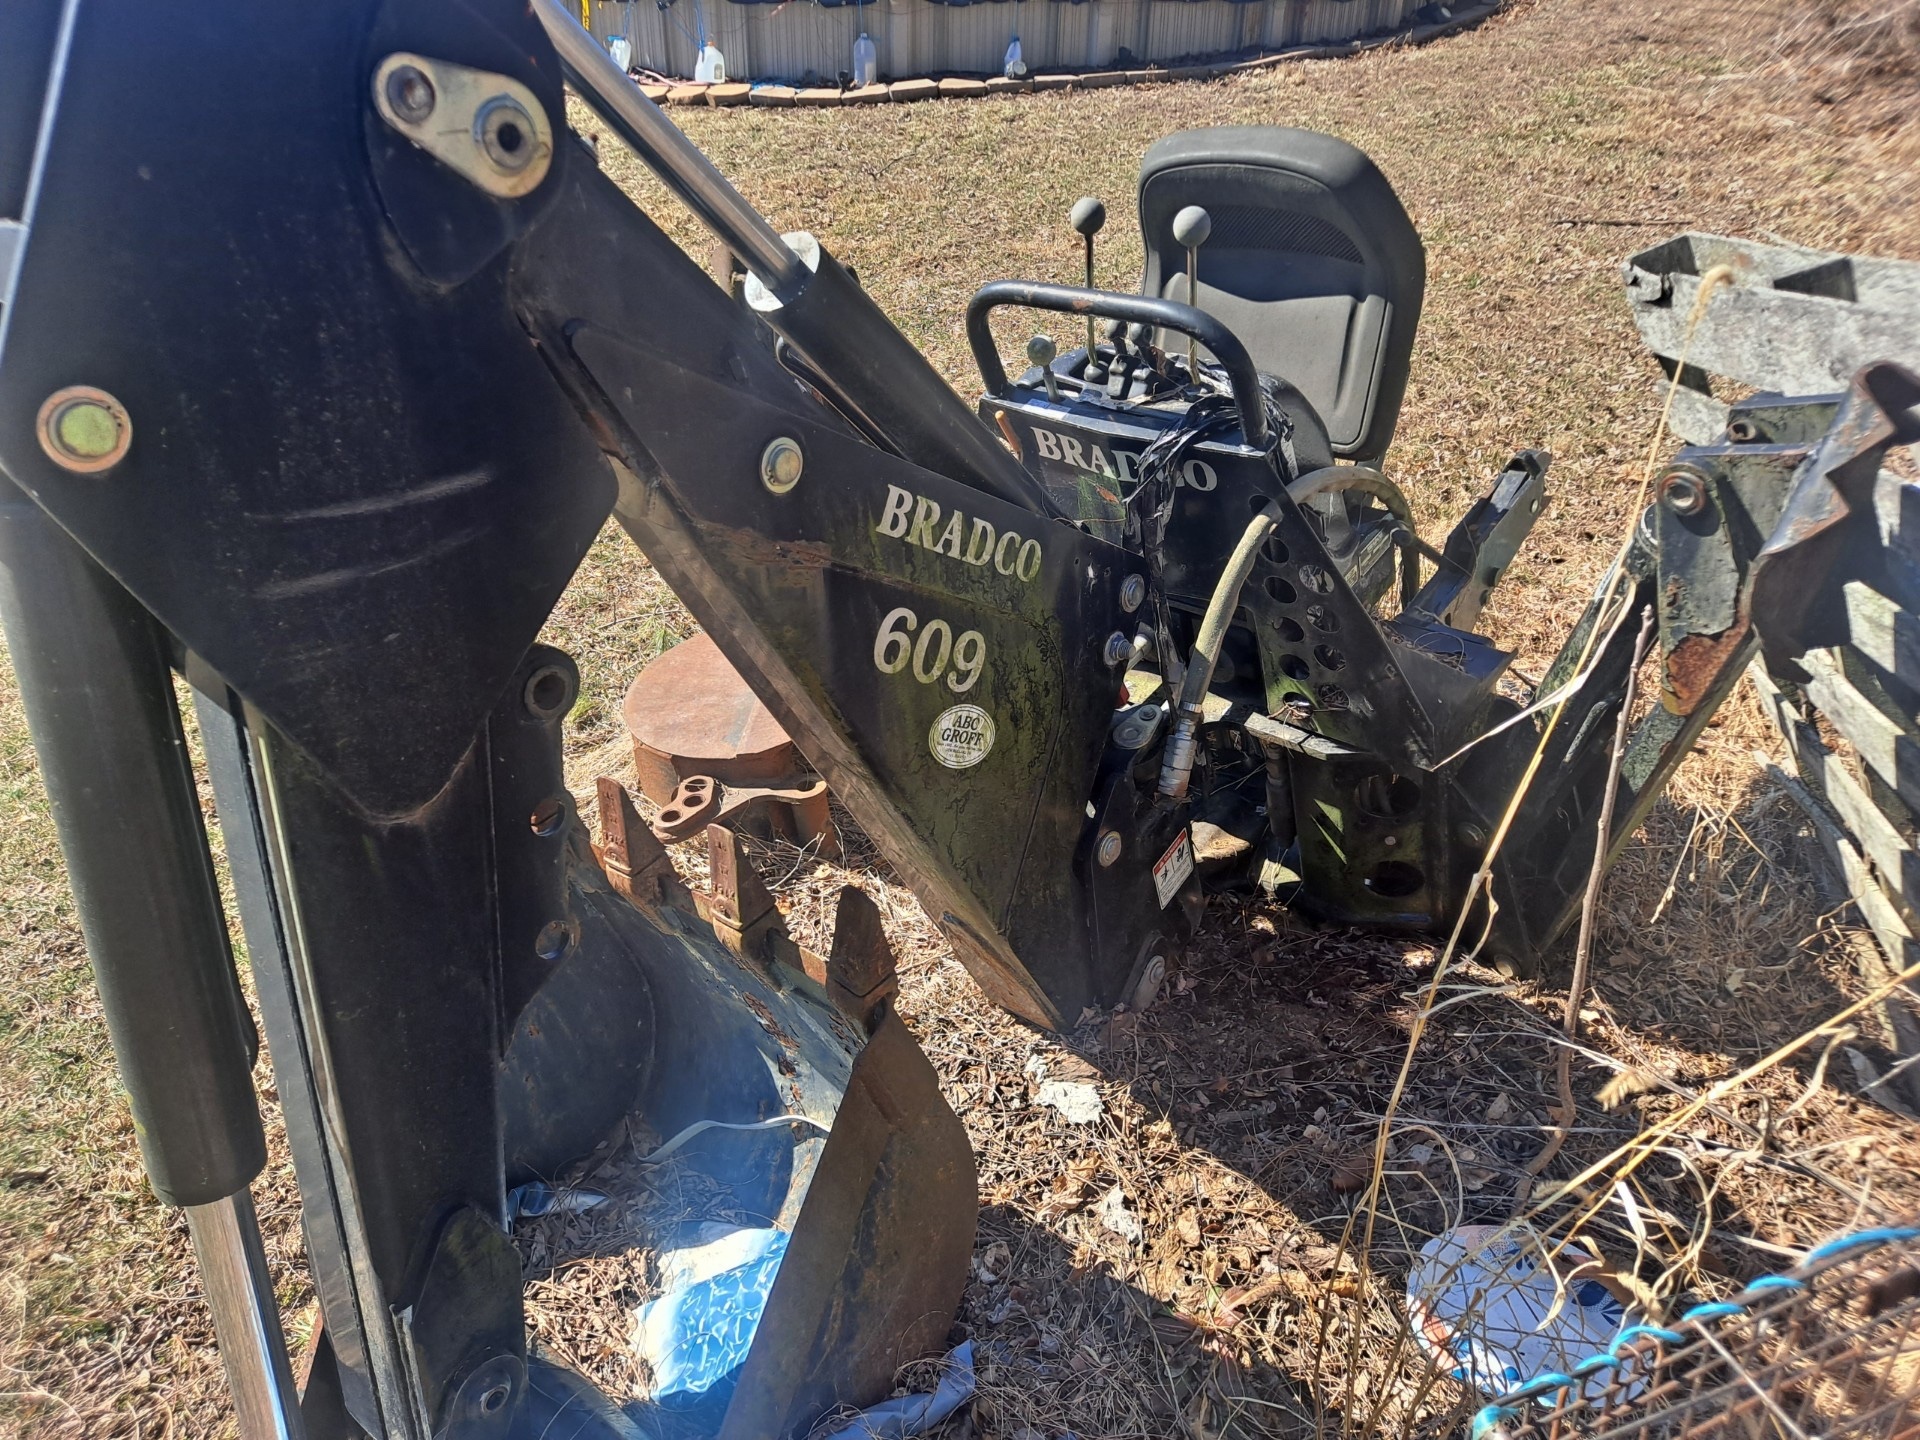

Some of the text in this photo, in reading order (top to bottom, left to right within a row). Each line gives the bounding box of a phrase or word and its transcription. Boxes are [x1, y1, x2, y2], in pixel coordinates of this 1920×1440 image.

[875, 483, 1042, 582] BRADCO
[873, 607, 986, 693] 609
[941, 727, 985, 746] GROFF
[952, 714, 980, 731] ABC
